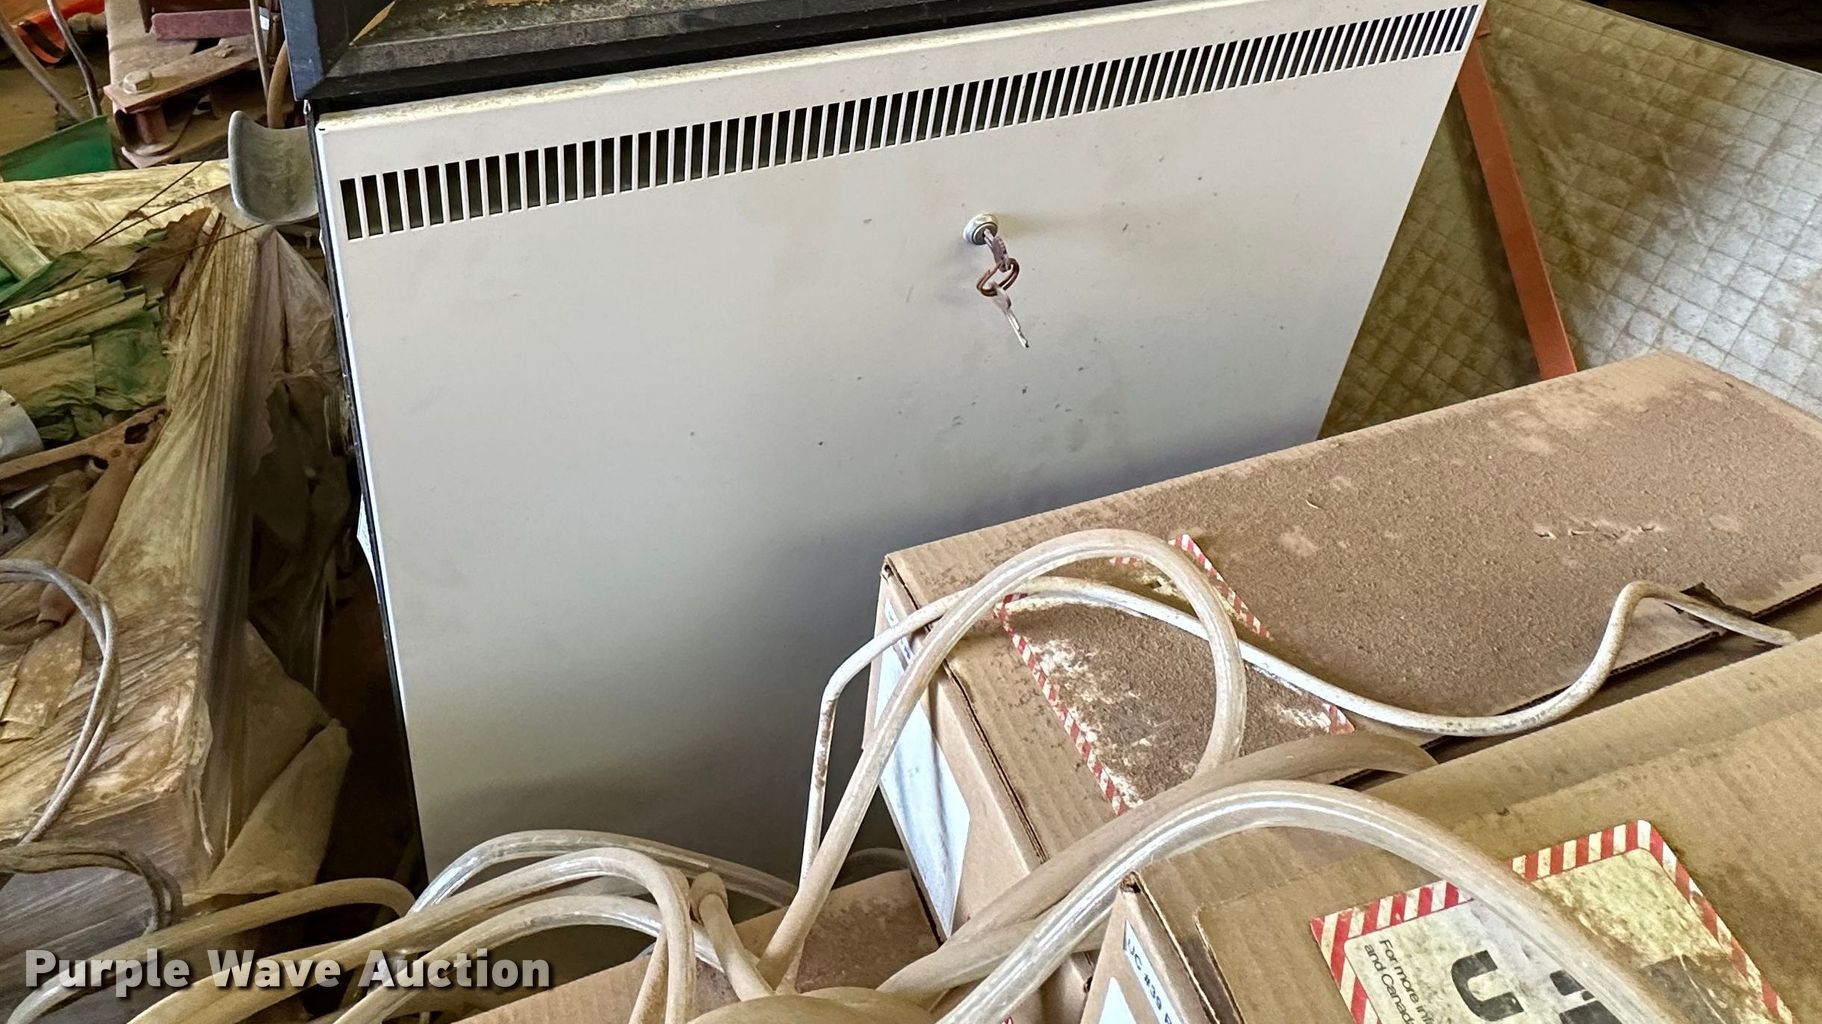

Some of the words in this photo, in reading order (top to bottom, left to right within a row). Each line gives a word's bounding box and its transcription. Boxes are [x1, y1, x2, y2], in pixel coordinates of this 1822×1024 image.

[1364, 944, 1387, 972] and
[1379, 939, 1399, 966] For
[1394, 965, 1420, 1003] more
[1416, 1005, 1435, 1024] inf
